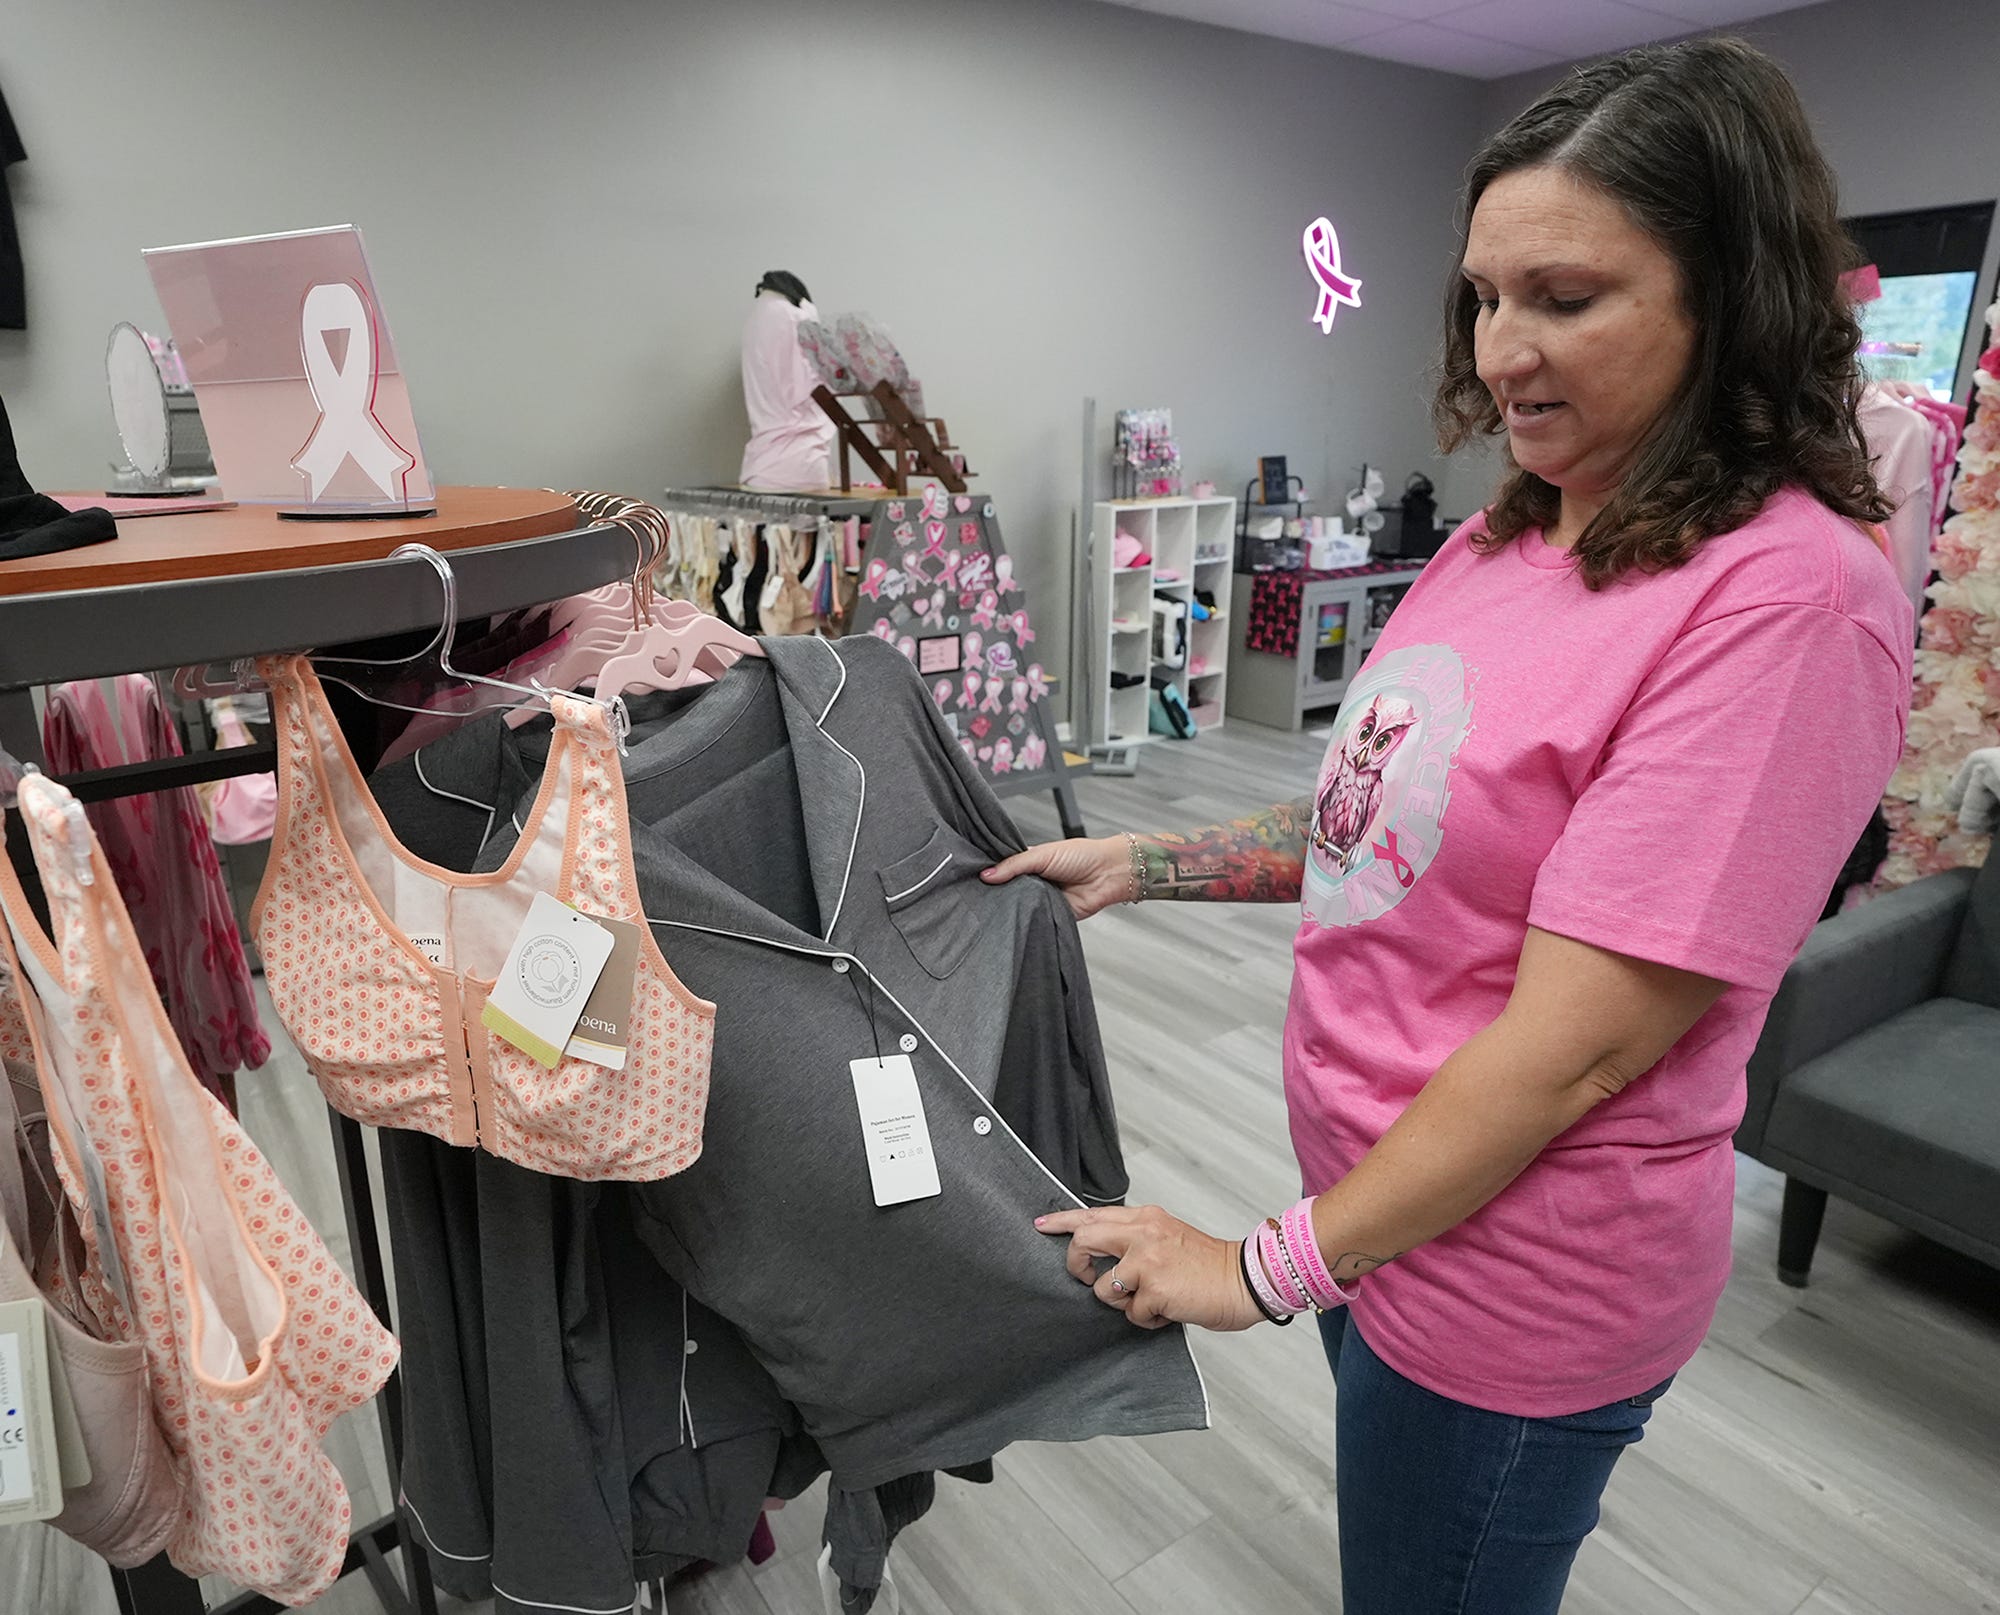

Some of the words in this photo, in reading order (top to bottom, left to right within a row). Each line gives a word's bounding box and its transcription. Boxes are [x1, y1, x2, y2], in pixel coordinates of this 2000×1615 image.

[1343, 656, 1461, 920] EMBRACE.PNK
[410, 937, 442, 946] oena
[523, 945, 534, 959] high
[533, 938, 554, 948] cotton
[554, 940, 575, 960] content
[579, 1015, 617, 1036] oena
[1247, 1249, 1273, 1302] CANCER
